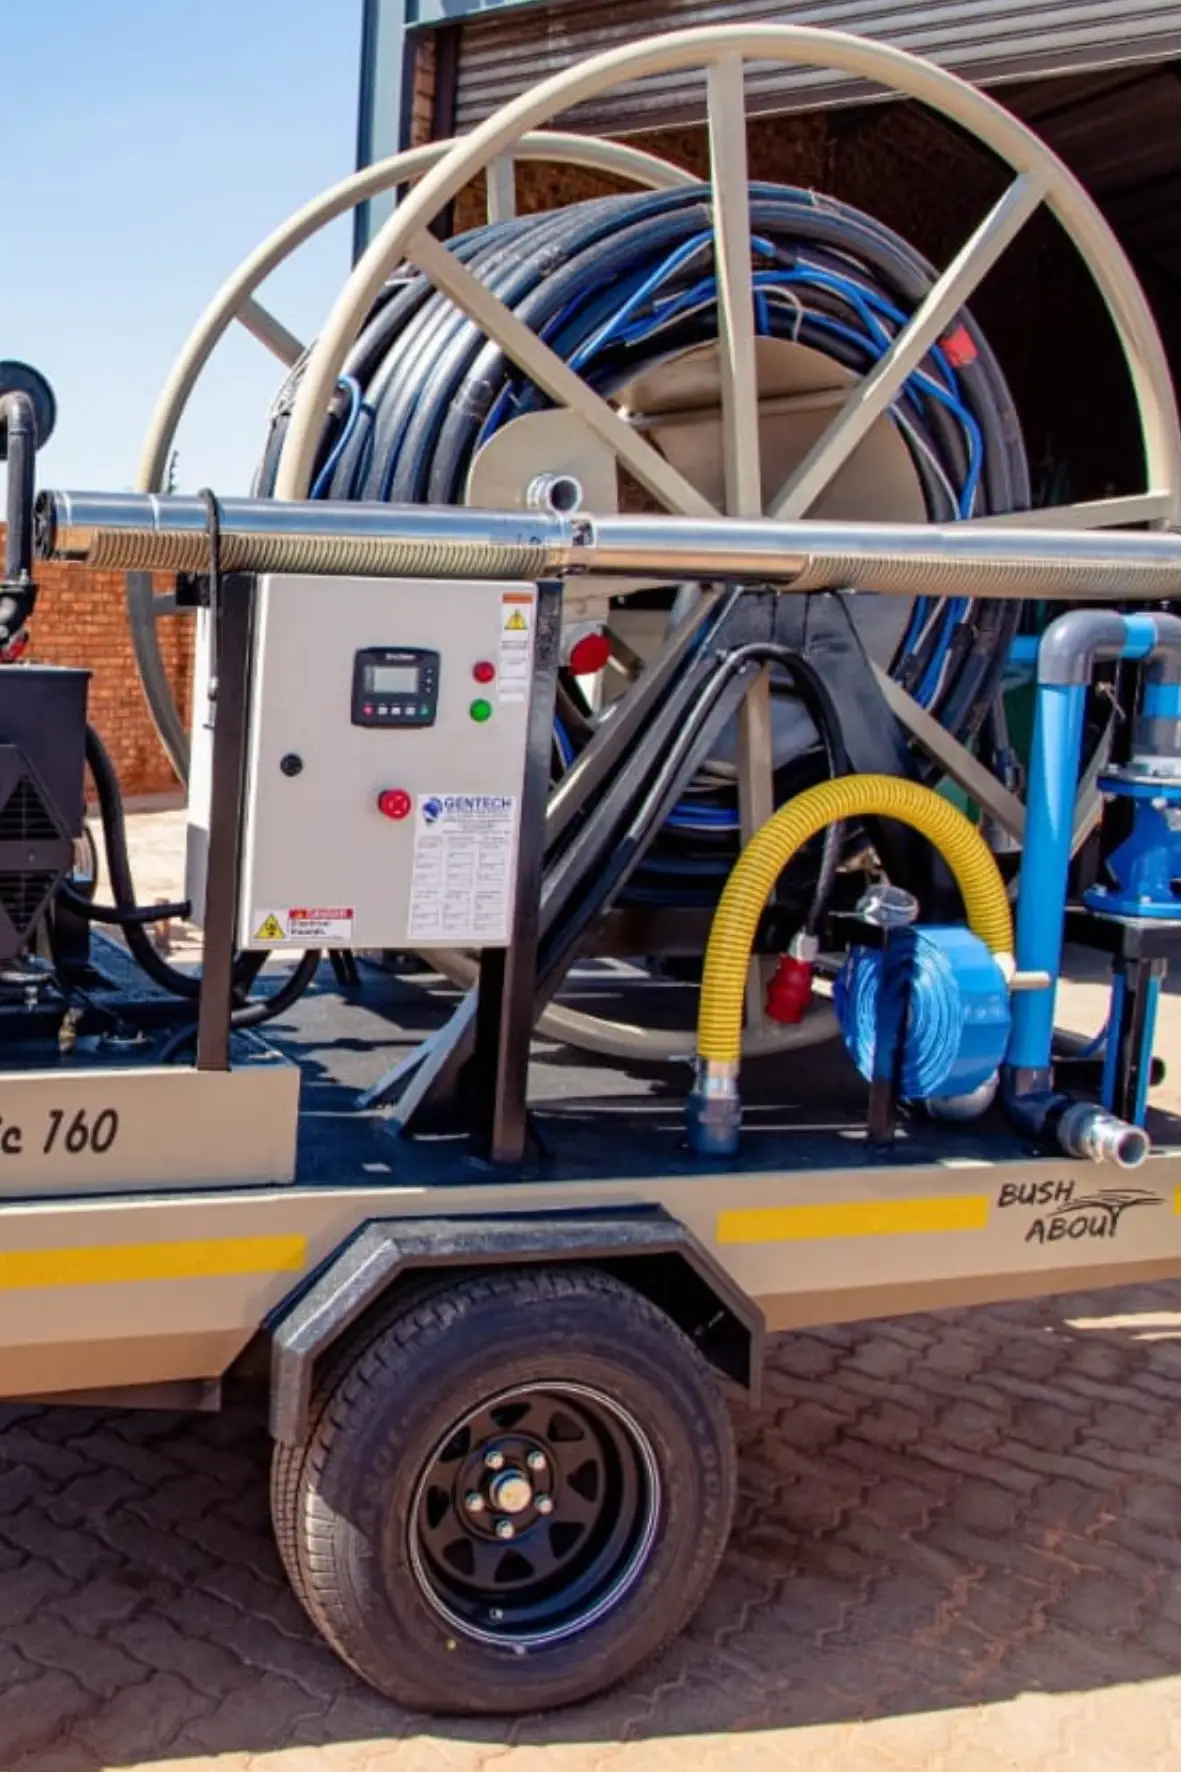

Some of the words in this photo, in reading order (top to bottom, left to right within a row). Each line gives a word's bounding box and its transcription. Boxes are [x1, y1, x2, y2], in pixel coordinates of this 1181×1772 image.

[444, 797, 512, 812] GENTECH
[0, 1112, 23, 1154] c
[43, 1108, 119, 1154] 160
[997, 1180, 1075, 1208] BUSH
